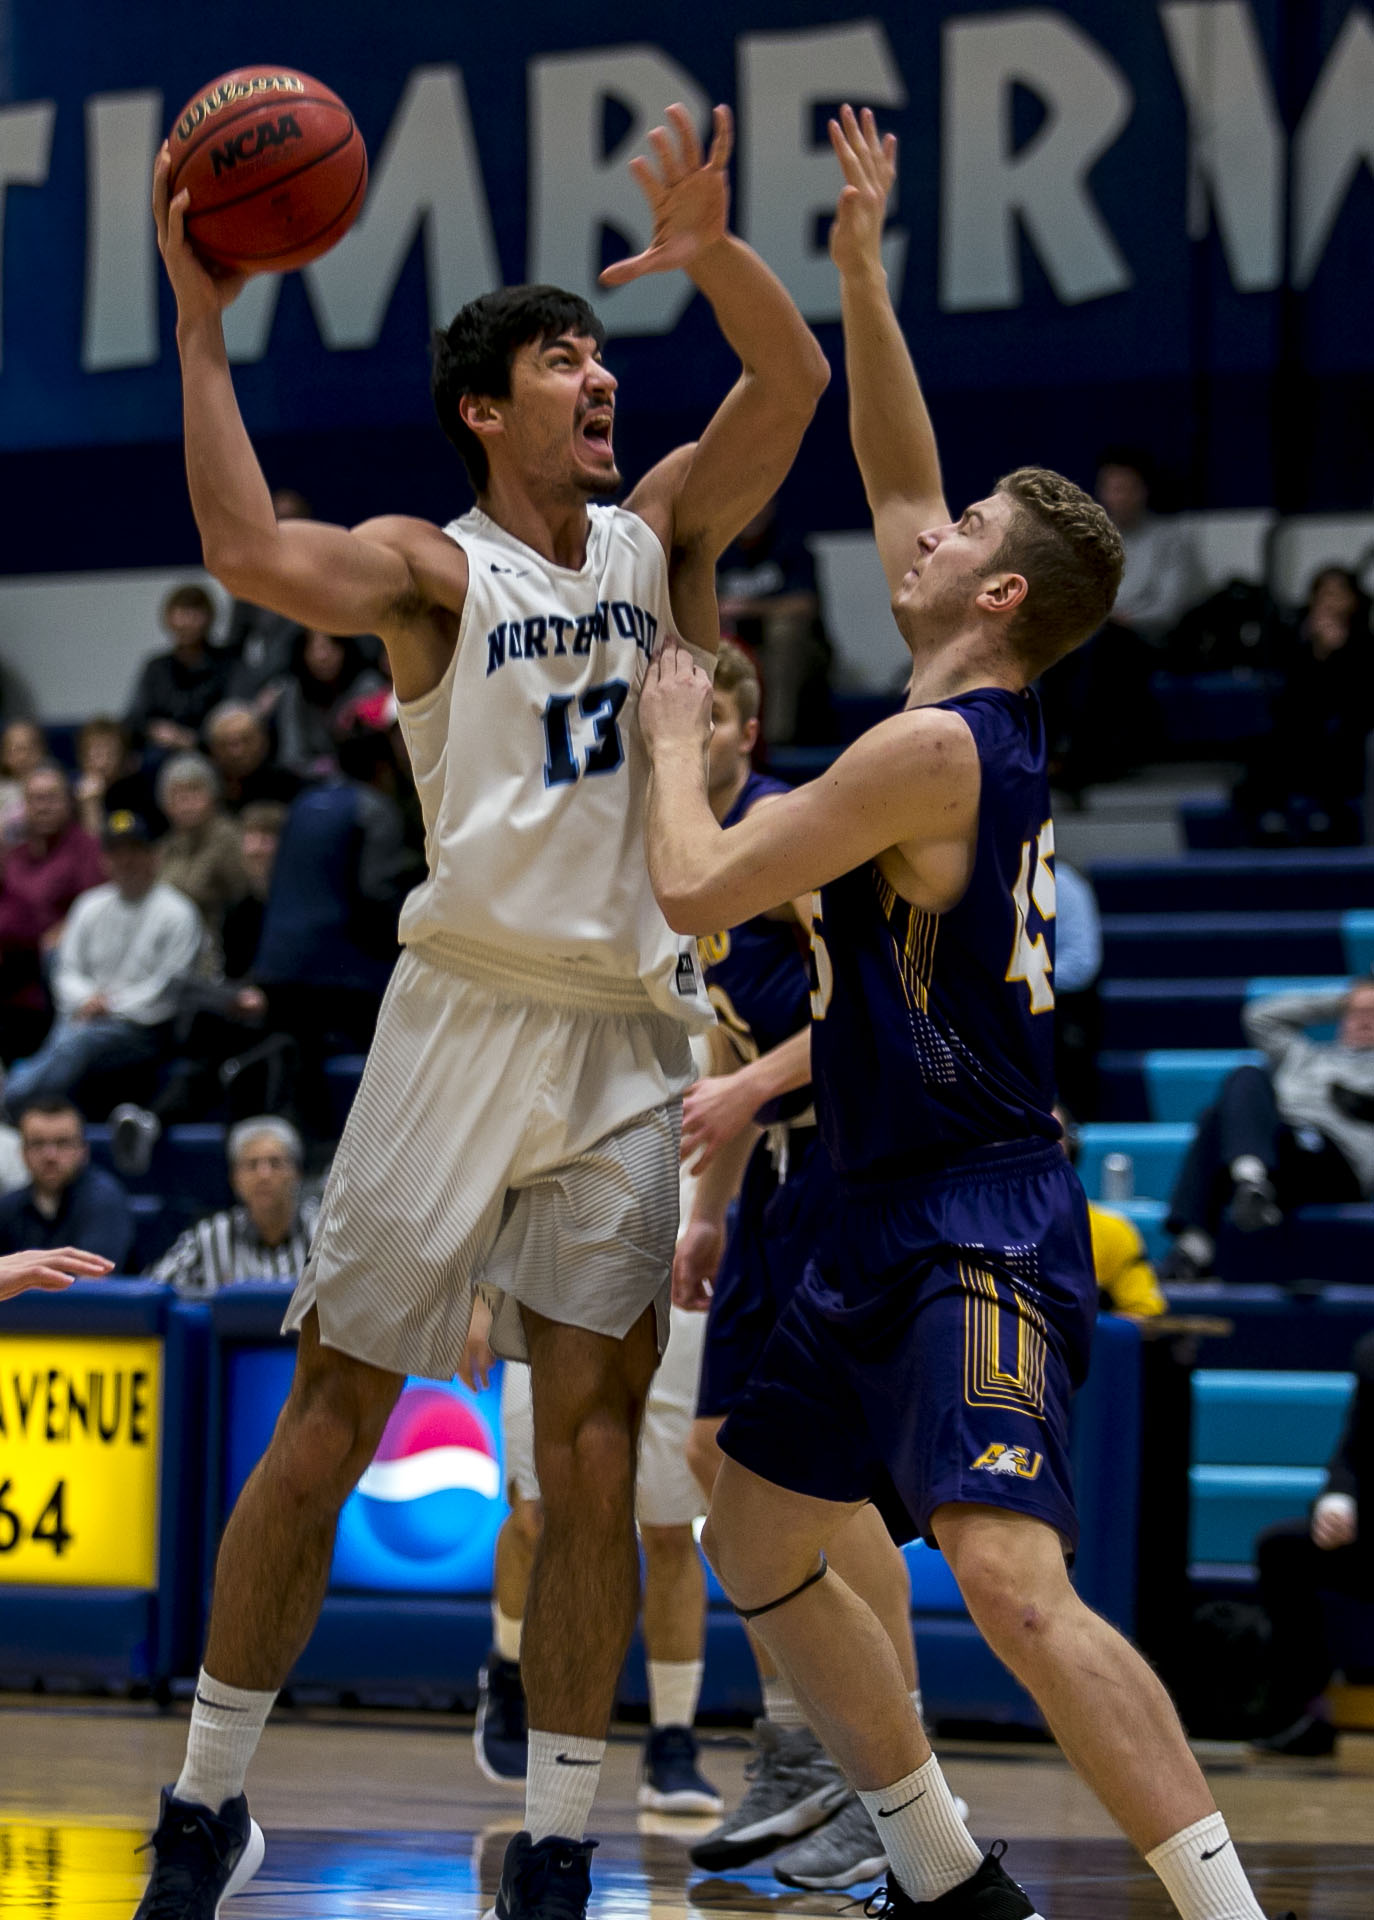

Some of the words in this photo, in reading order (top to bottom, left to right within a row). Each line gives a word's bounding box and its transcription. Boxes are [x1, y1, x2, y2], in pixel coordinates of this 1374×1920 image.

[209, 112, 303, 176] NCAA
[544, 677, 630, 789] 13
[0, 1369, 150, 1445] VENUE
